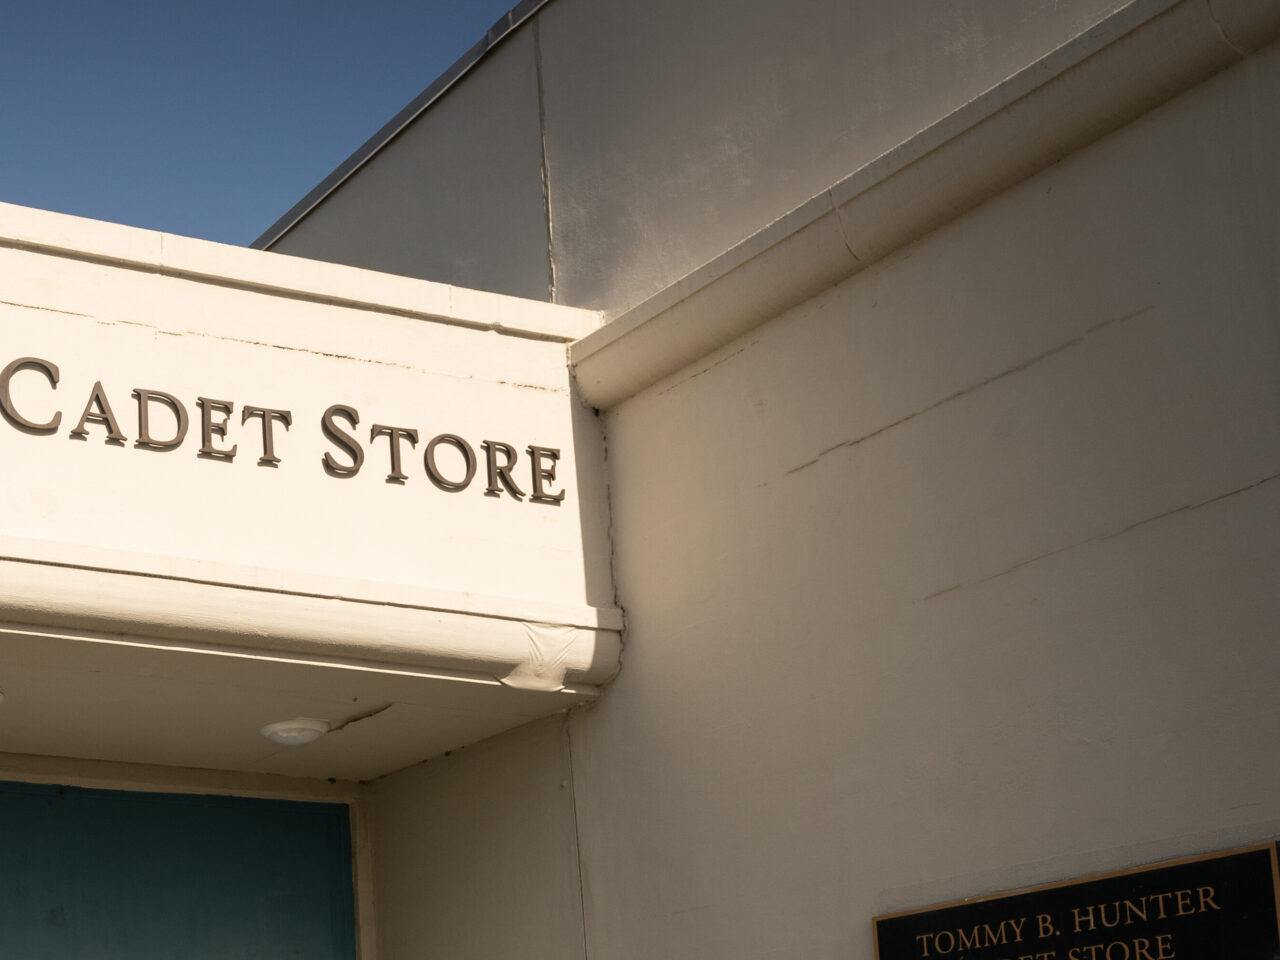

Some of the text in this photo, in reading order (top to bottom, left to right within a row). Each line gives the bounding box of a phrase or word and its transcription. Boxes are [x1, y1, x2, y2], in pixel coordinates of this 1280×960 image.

[321, 403, 566, 506] STORE
[916, 886, 1221, 957] TOMMY B. HUNTER
